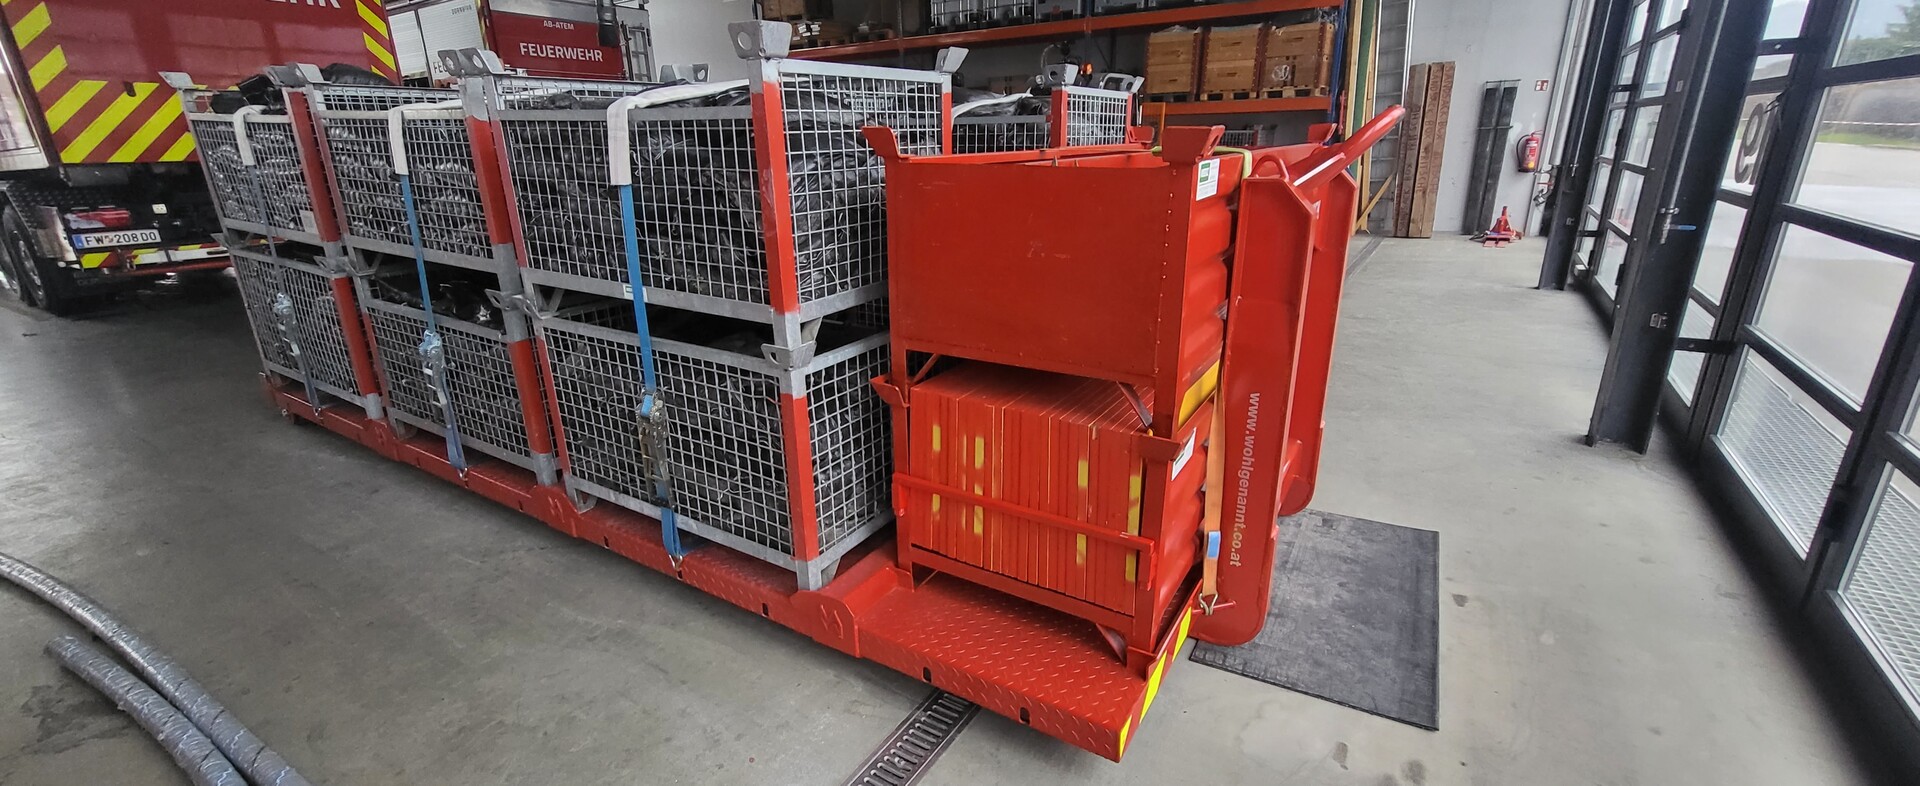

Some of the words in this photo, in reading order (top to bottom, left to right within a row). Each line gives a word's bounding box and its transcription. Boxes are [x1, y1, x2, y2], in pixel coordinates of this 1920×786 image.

[543, 20, 574, 30] AB-ATEM
[520, 42, 603, 62] FEUERWEHR
[85, 235, 104, 246] FW
[1230, 392, 1260, 568] www.wohlgenannt.co.at
